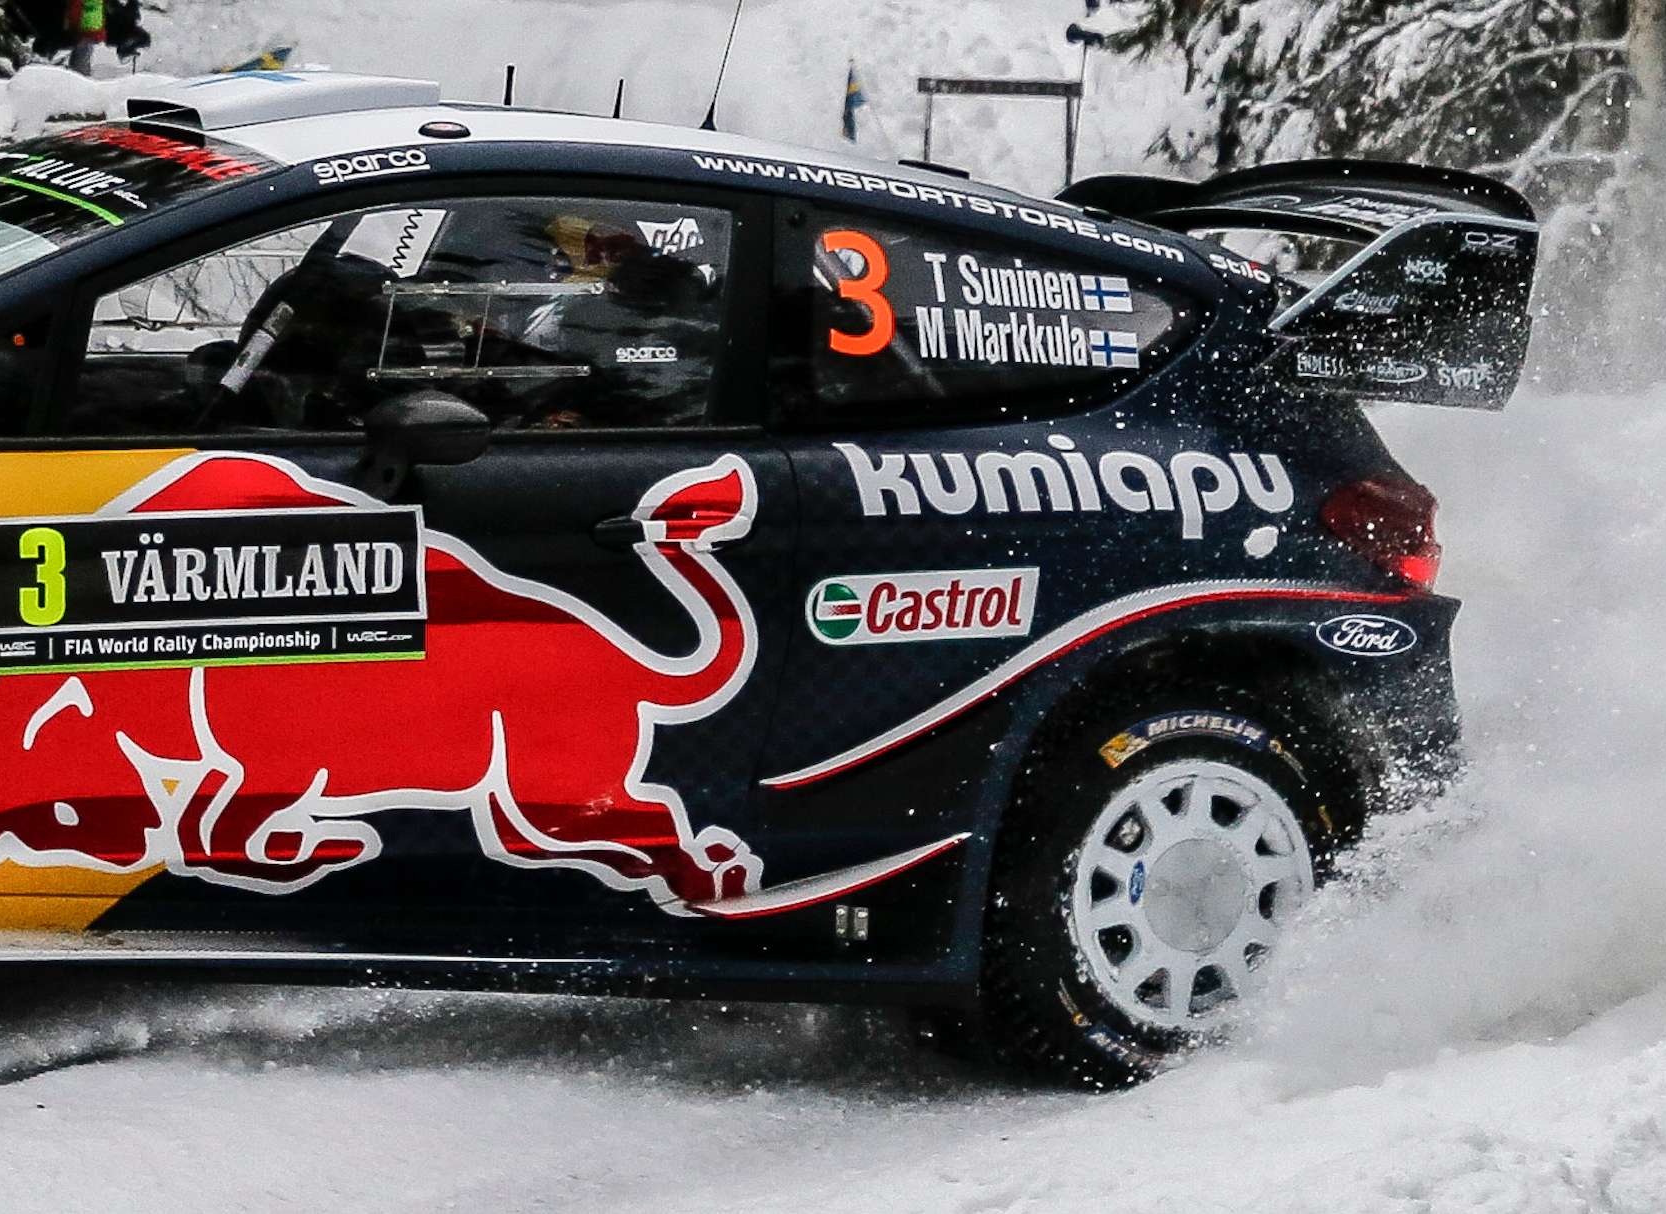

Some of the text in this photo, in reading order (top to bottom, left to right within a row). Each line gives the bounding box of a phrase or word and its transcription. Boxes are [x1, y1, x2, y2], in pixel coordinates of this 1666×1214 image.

[313, 148, 428, 183] sparco
[693, 154, 1186, 264] www.MSPORTSTORE.com
[821, 228, 897, 357] 3
[923, 251, 1083, 310] T Suninen
[1209, 252, 1272, 285] stilo
[616, 346, 678, 364] sparco
[918, 303, 1088, 368] M Markkula
[832, 435, 1295, 540] kumiapu
[18, 527, 404, 626] 3 VÄRMLAND
[867, 578, 1023, 636] Castrol
[1334, 617, 1399, 653] Ford
[64, 631, 321, 655] FIA World Rally Championship
[1146, 715, 1264, 741] MICHELIN
